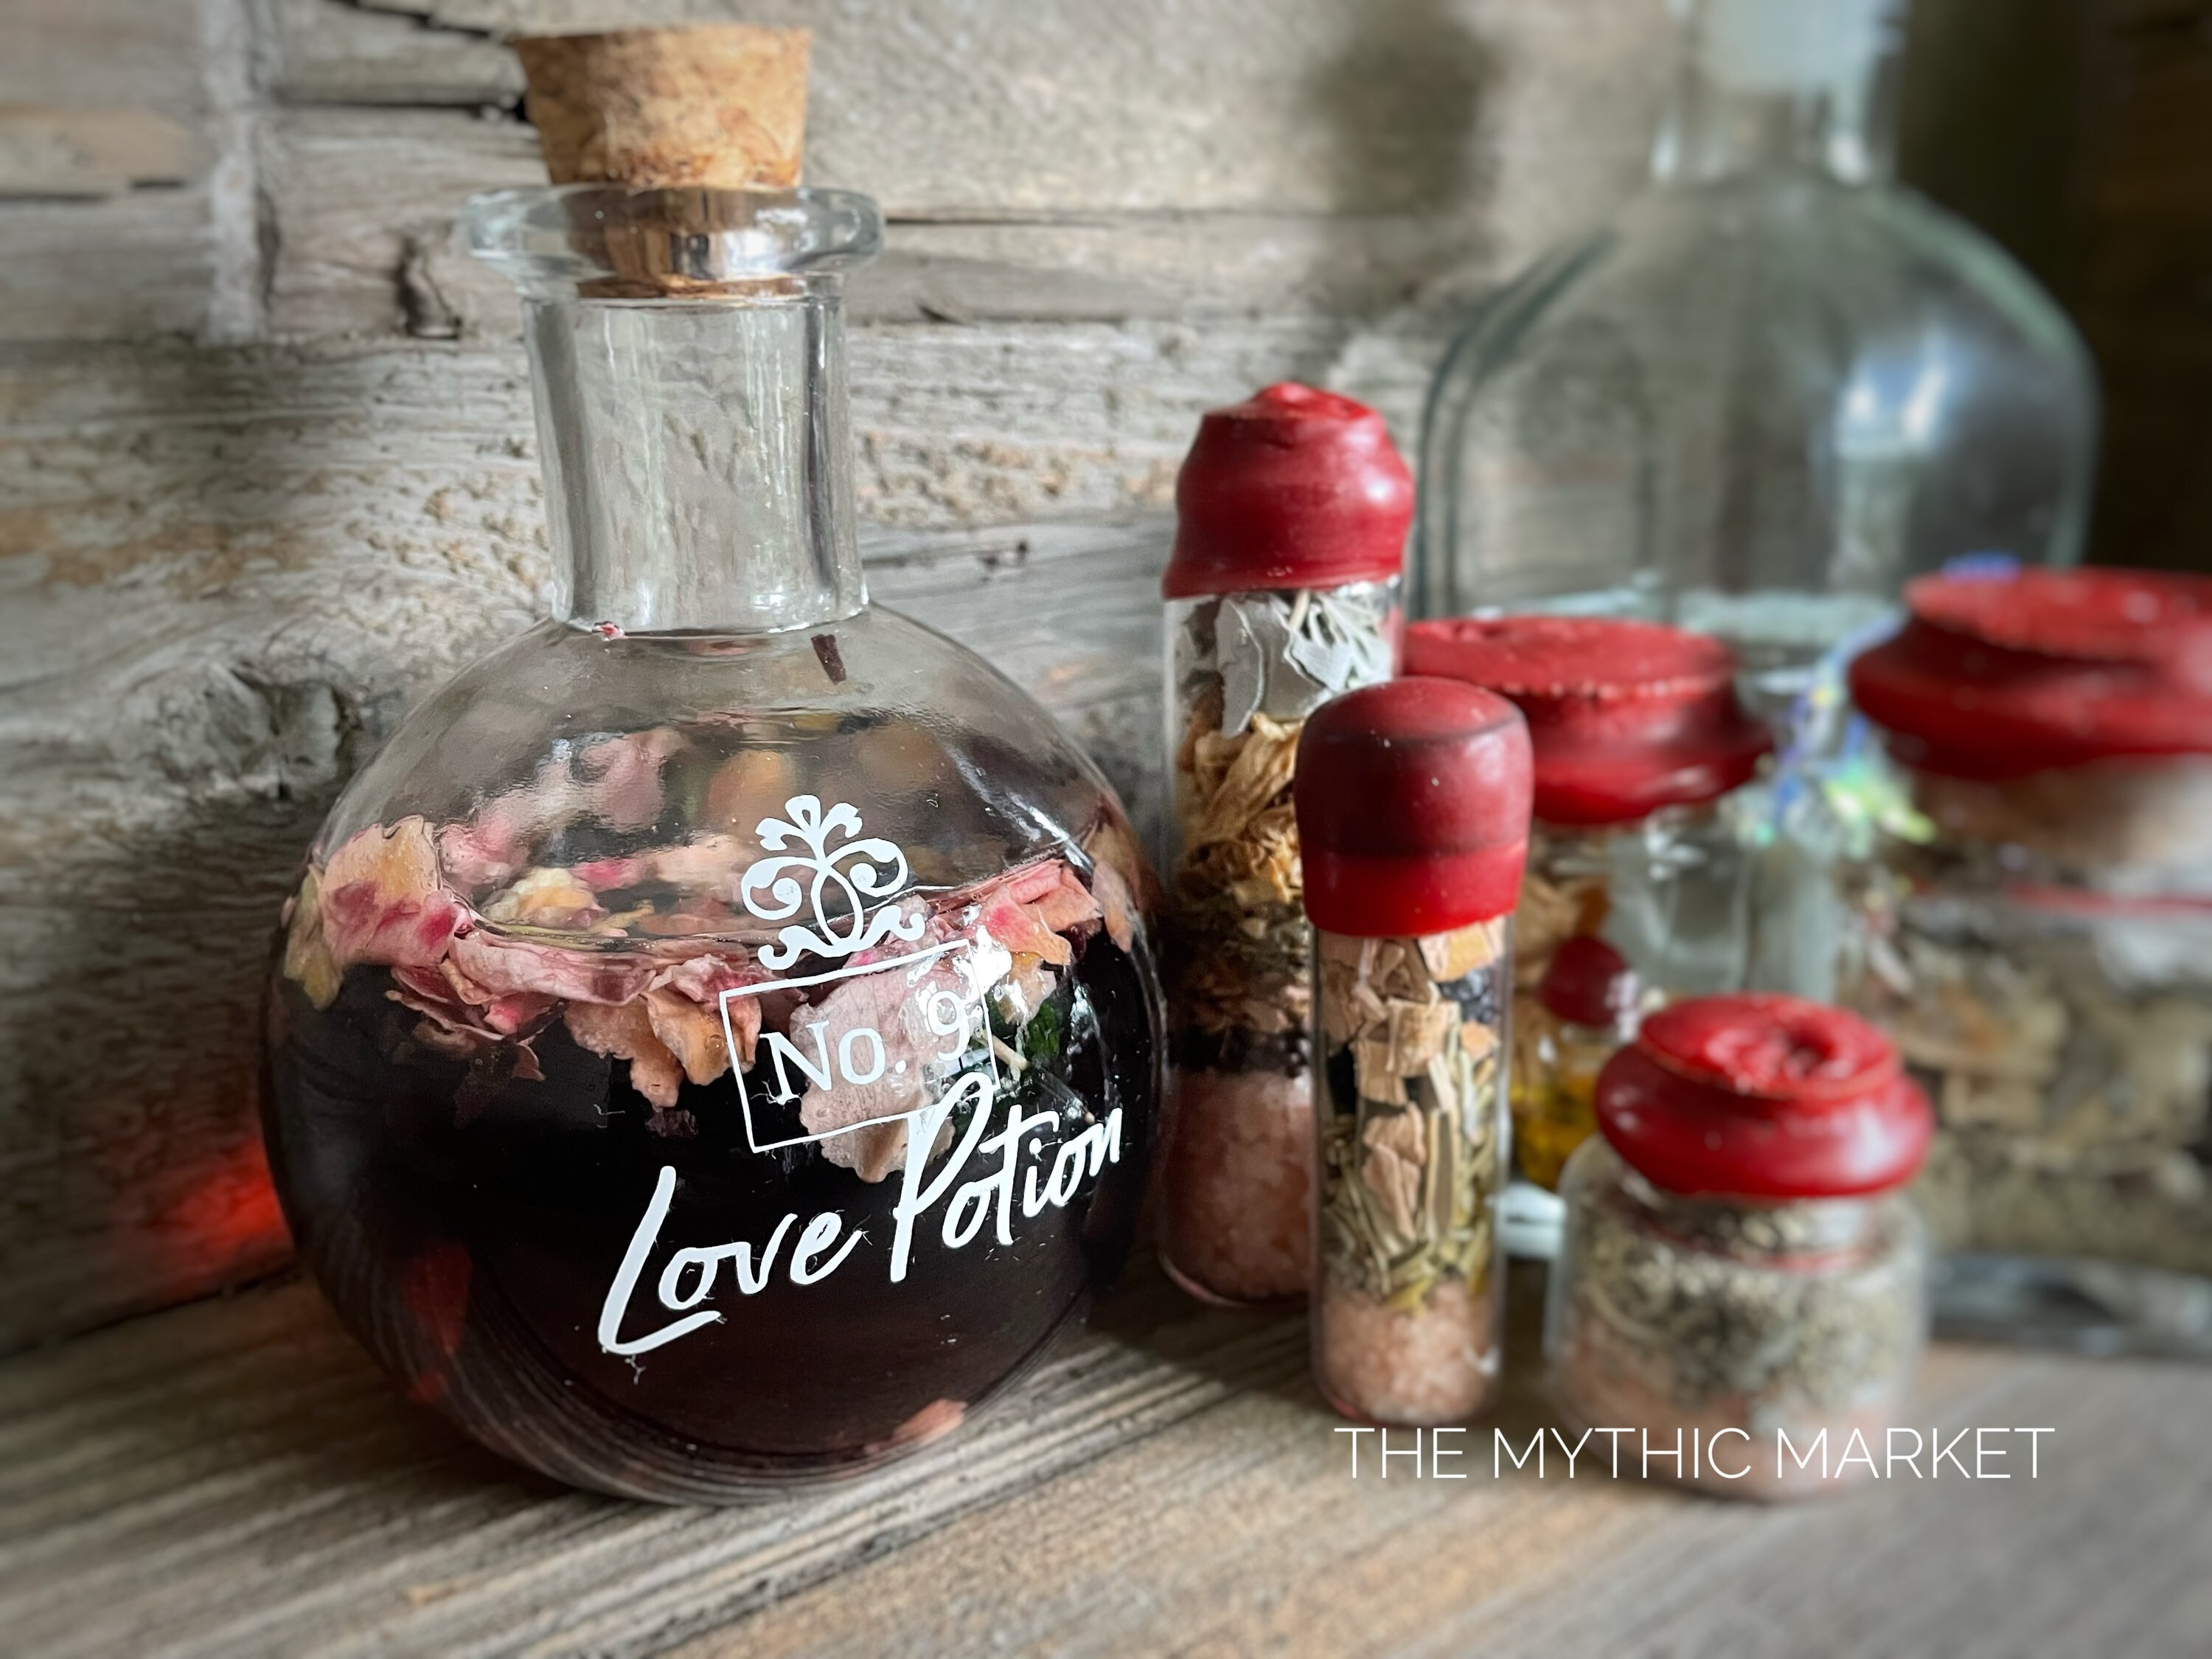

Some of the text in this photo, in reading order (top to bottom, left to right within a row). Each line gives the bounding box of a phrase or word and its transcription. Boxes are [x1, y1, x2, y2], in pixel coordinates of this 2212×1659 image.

[759, 989, 969, 1105] No. 9
[598, 1071, 1122, 1355] Love Potion
